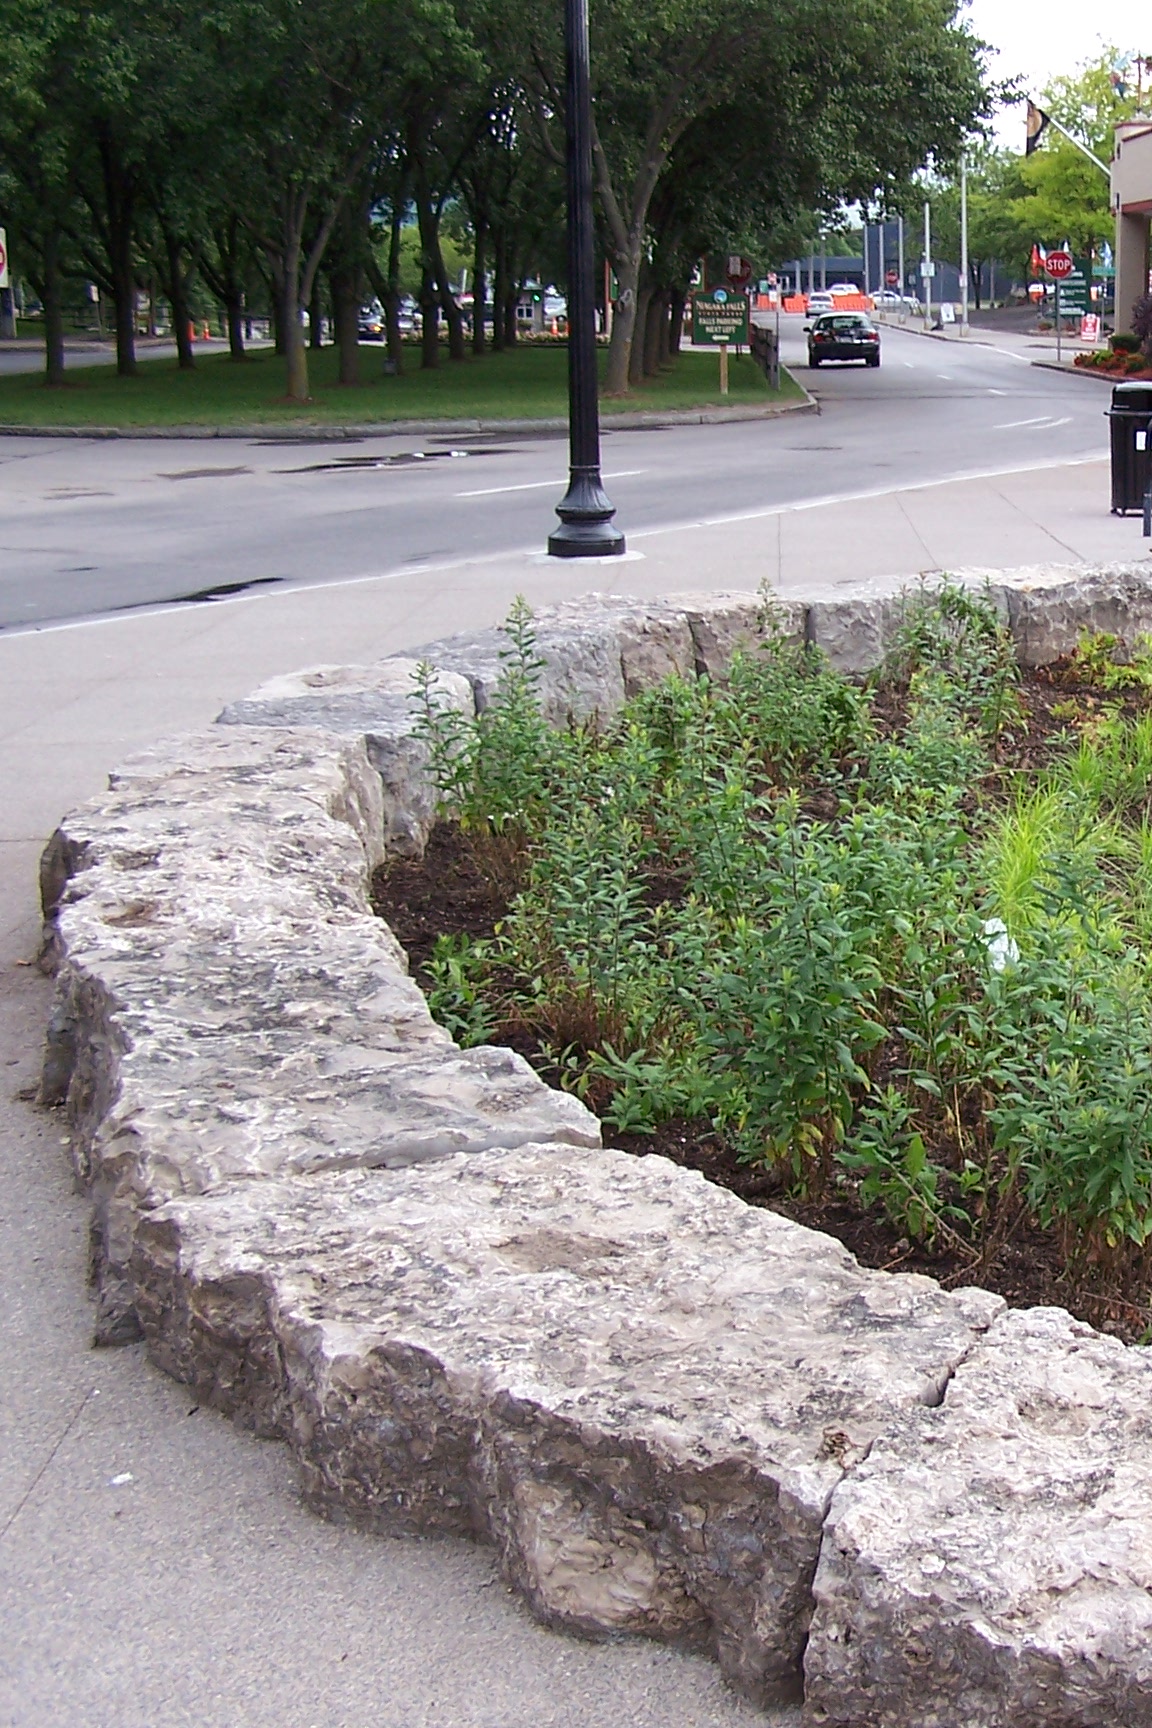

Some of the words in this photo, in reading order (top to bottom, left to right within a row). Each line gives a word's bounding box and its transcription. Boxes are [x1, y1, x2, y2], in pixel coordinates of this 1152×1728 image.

[1047, 259, 1071, 271] STOP
[696, 301, 725, 311] NIAGARA
[726, 301, 746, 311] FALLS
[716, 317, 743, 326] PARKING
[705, 325, 721, 333] NEXT
[722, 326, 736, 334] LEFT
